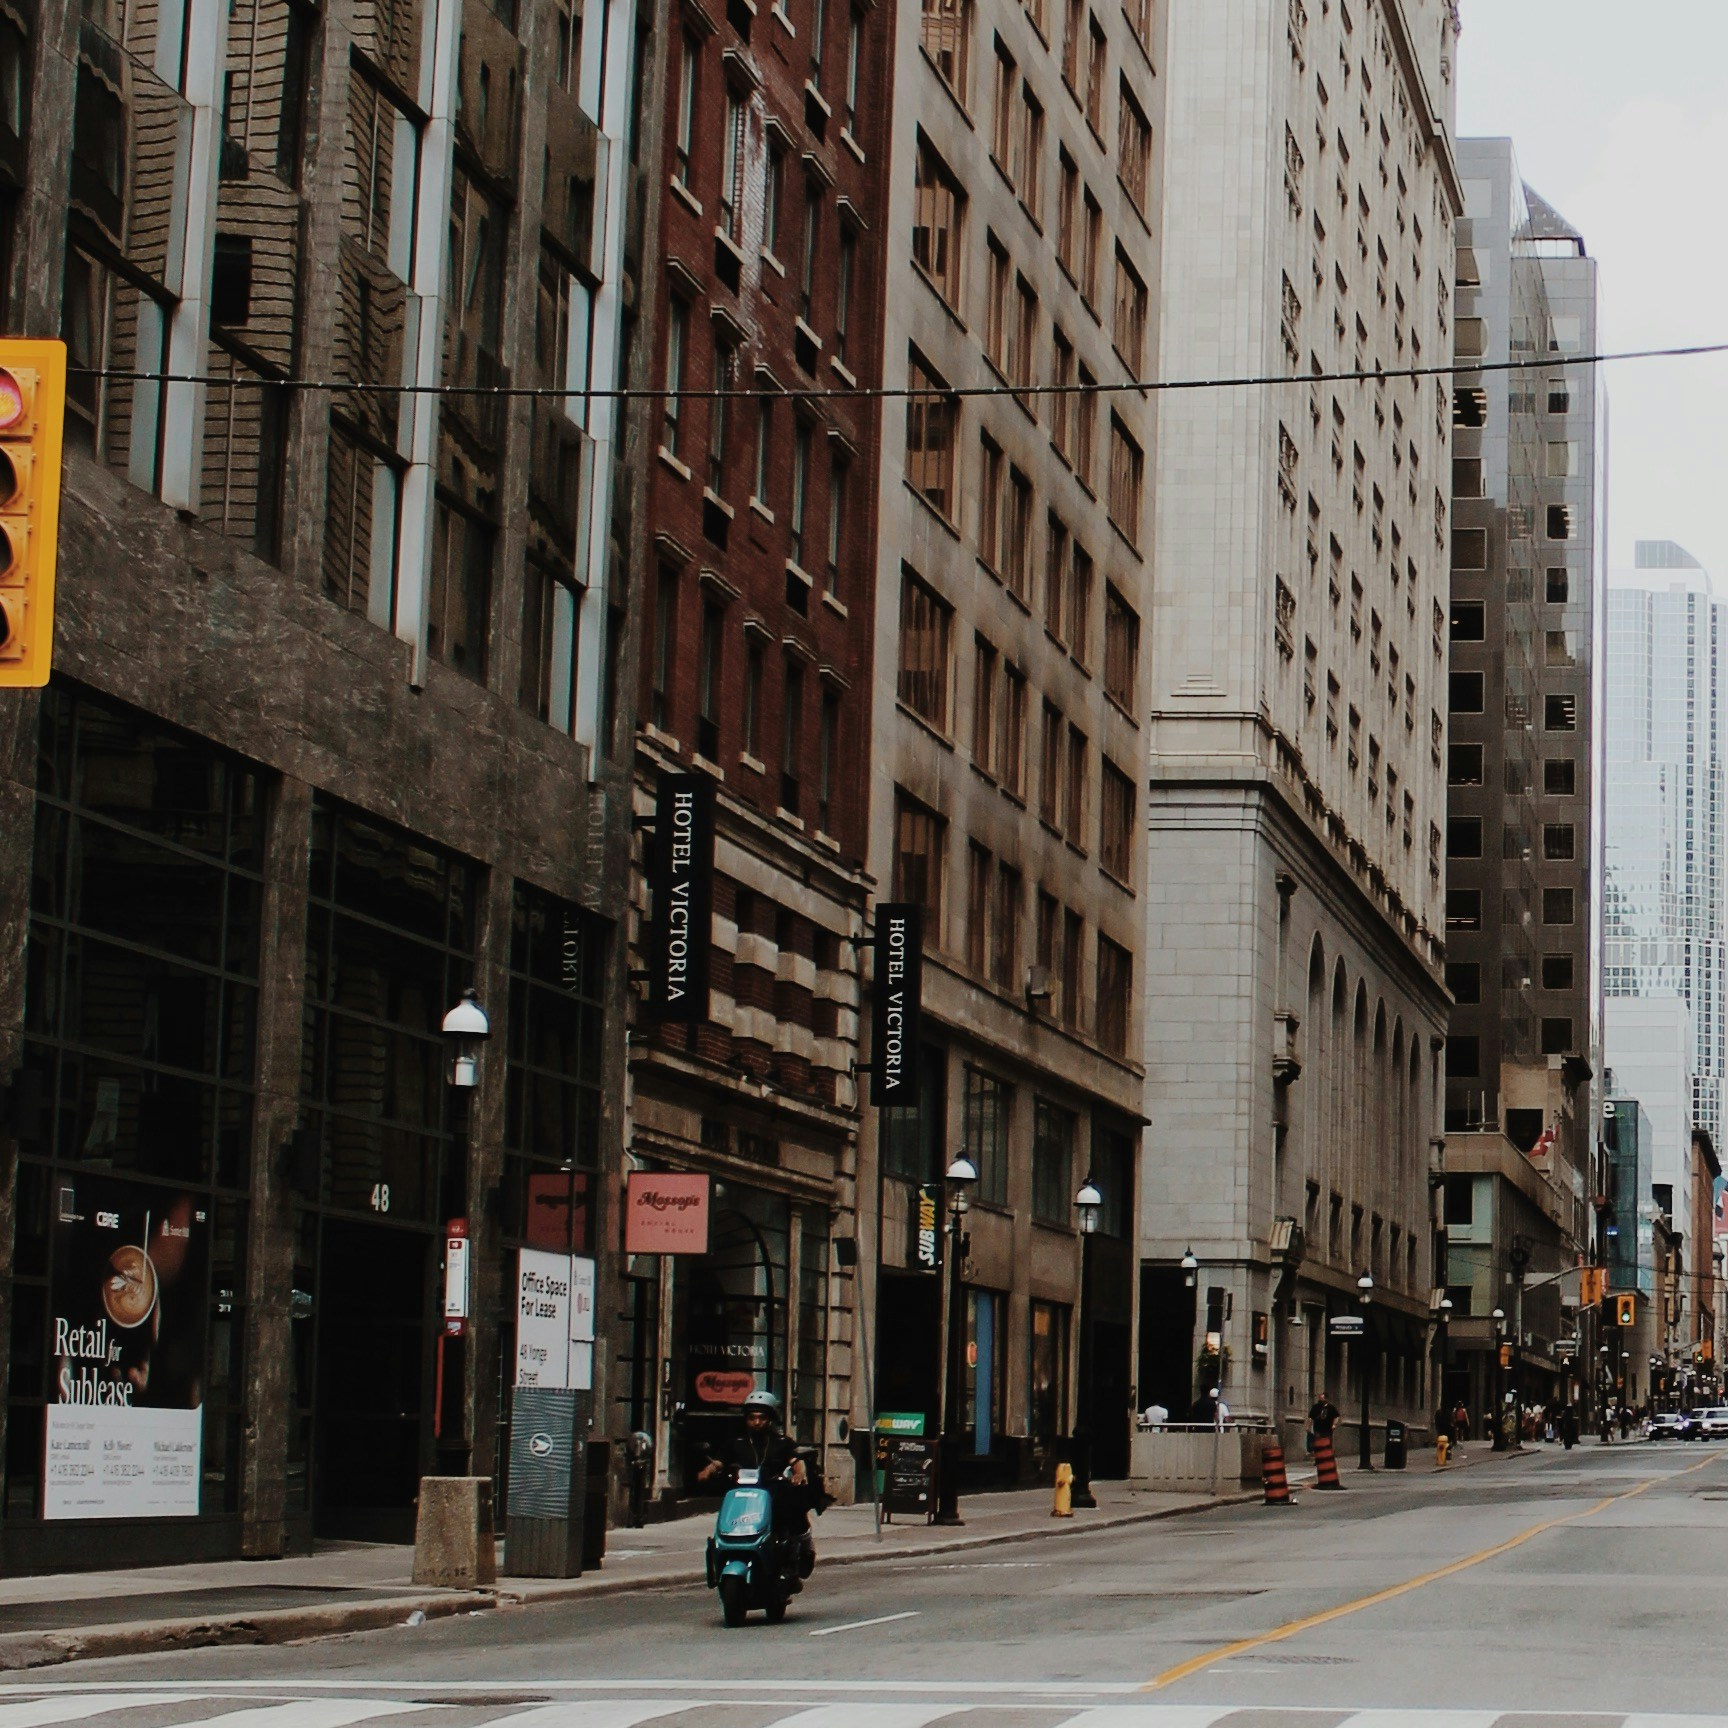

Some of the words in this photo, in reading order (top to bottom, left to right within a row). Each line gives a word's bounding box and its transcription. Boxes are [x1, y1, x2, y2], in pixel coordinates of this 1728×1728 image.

[672, 792, 693, 873] HOTEL
[667, 881, 690, 1002] VICTORIA
[888, 918, 905, 985] HOTEL
[886, 992, 904, 1090] VICTORIA
[371, 1183, 389, 1212] 48
[918, 1188, 937, 1266] SUBWAY
[521, 1272, 544, 1294] Office
[546, 1275, 568, 1300] Space
[521, 1295, 534, 1316] For
[535, 1297, 557, 1319] Lease
[54, 1317, 107, 1359] Retail
[105, 1338, 122, 1367] for
[719, 1345, 765, 1357] VICTORIA
[59, 1367, 133, 1407] Sublease
